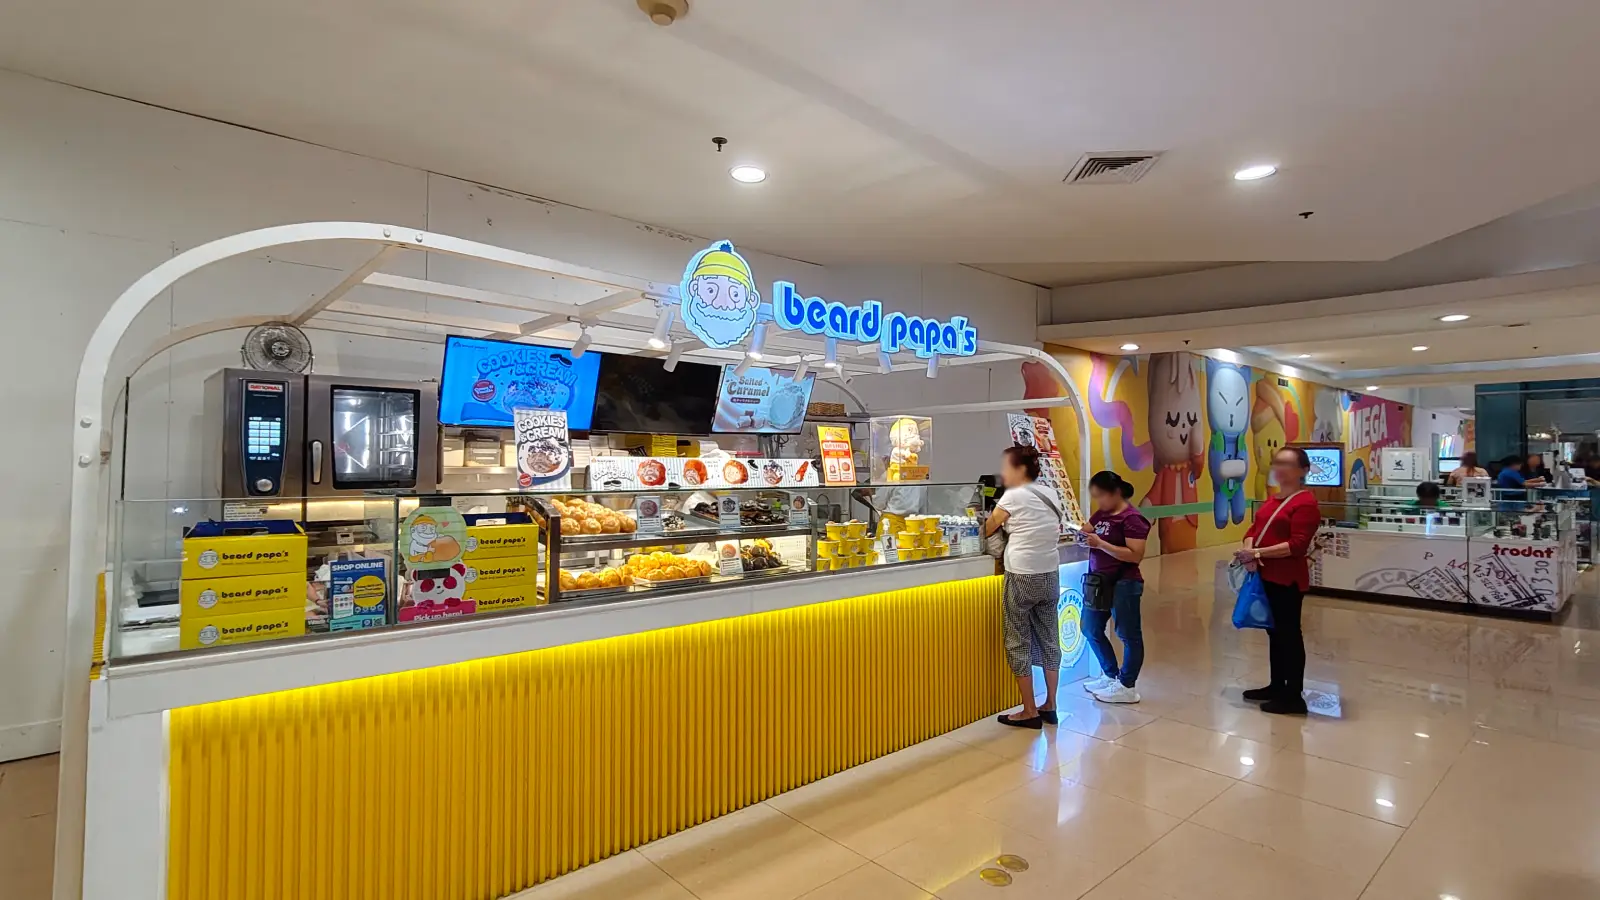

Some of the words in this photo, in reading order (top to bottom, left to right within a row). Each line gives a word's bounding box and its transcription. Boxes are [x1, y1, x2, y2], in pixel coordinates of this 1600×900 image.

[776, 282, 883, 340] beard
[885, 313, 978, 357] papa's
[477, 349, 546, 374] COOKIES
[739, 376, 764, 386] Salted
[727, 381, 770, 397] Caramel
[518, 415, 565, 433] COOKIES
[1348, 403, 1388, 453] MEGA
[503, 537, 526, 545] papa's
[222, 552, 253, 560] beard
[256, 550, 289, 560] papa's
[1492, 544, 1554, 558] trodat
[503, 566, 526, 575] papa's
[222, 589, 252, 598] beard
[255, 586, 288, 597] papa's
[479, 598, 500, 606] beard
[502, 596, 525, 604] papa's
[222, 624, 253, 634] beard
[256, 621, 289, 632] papa's
